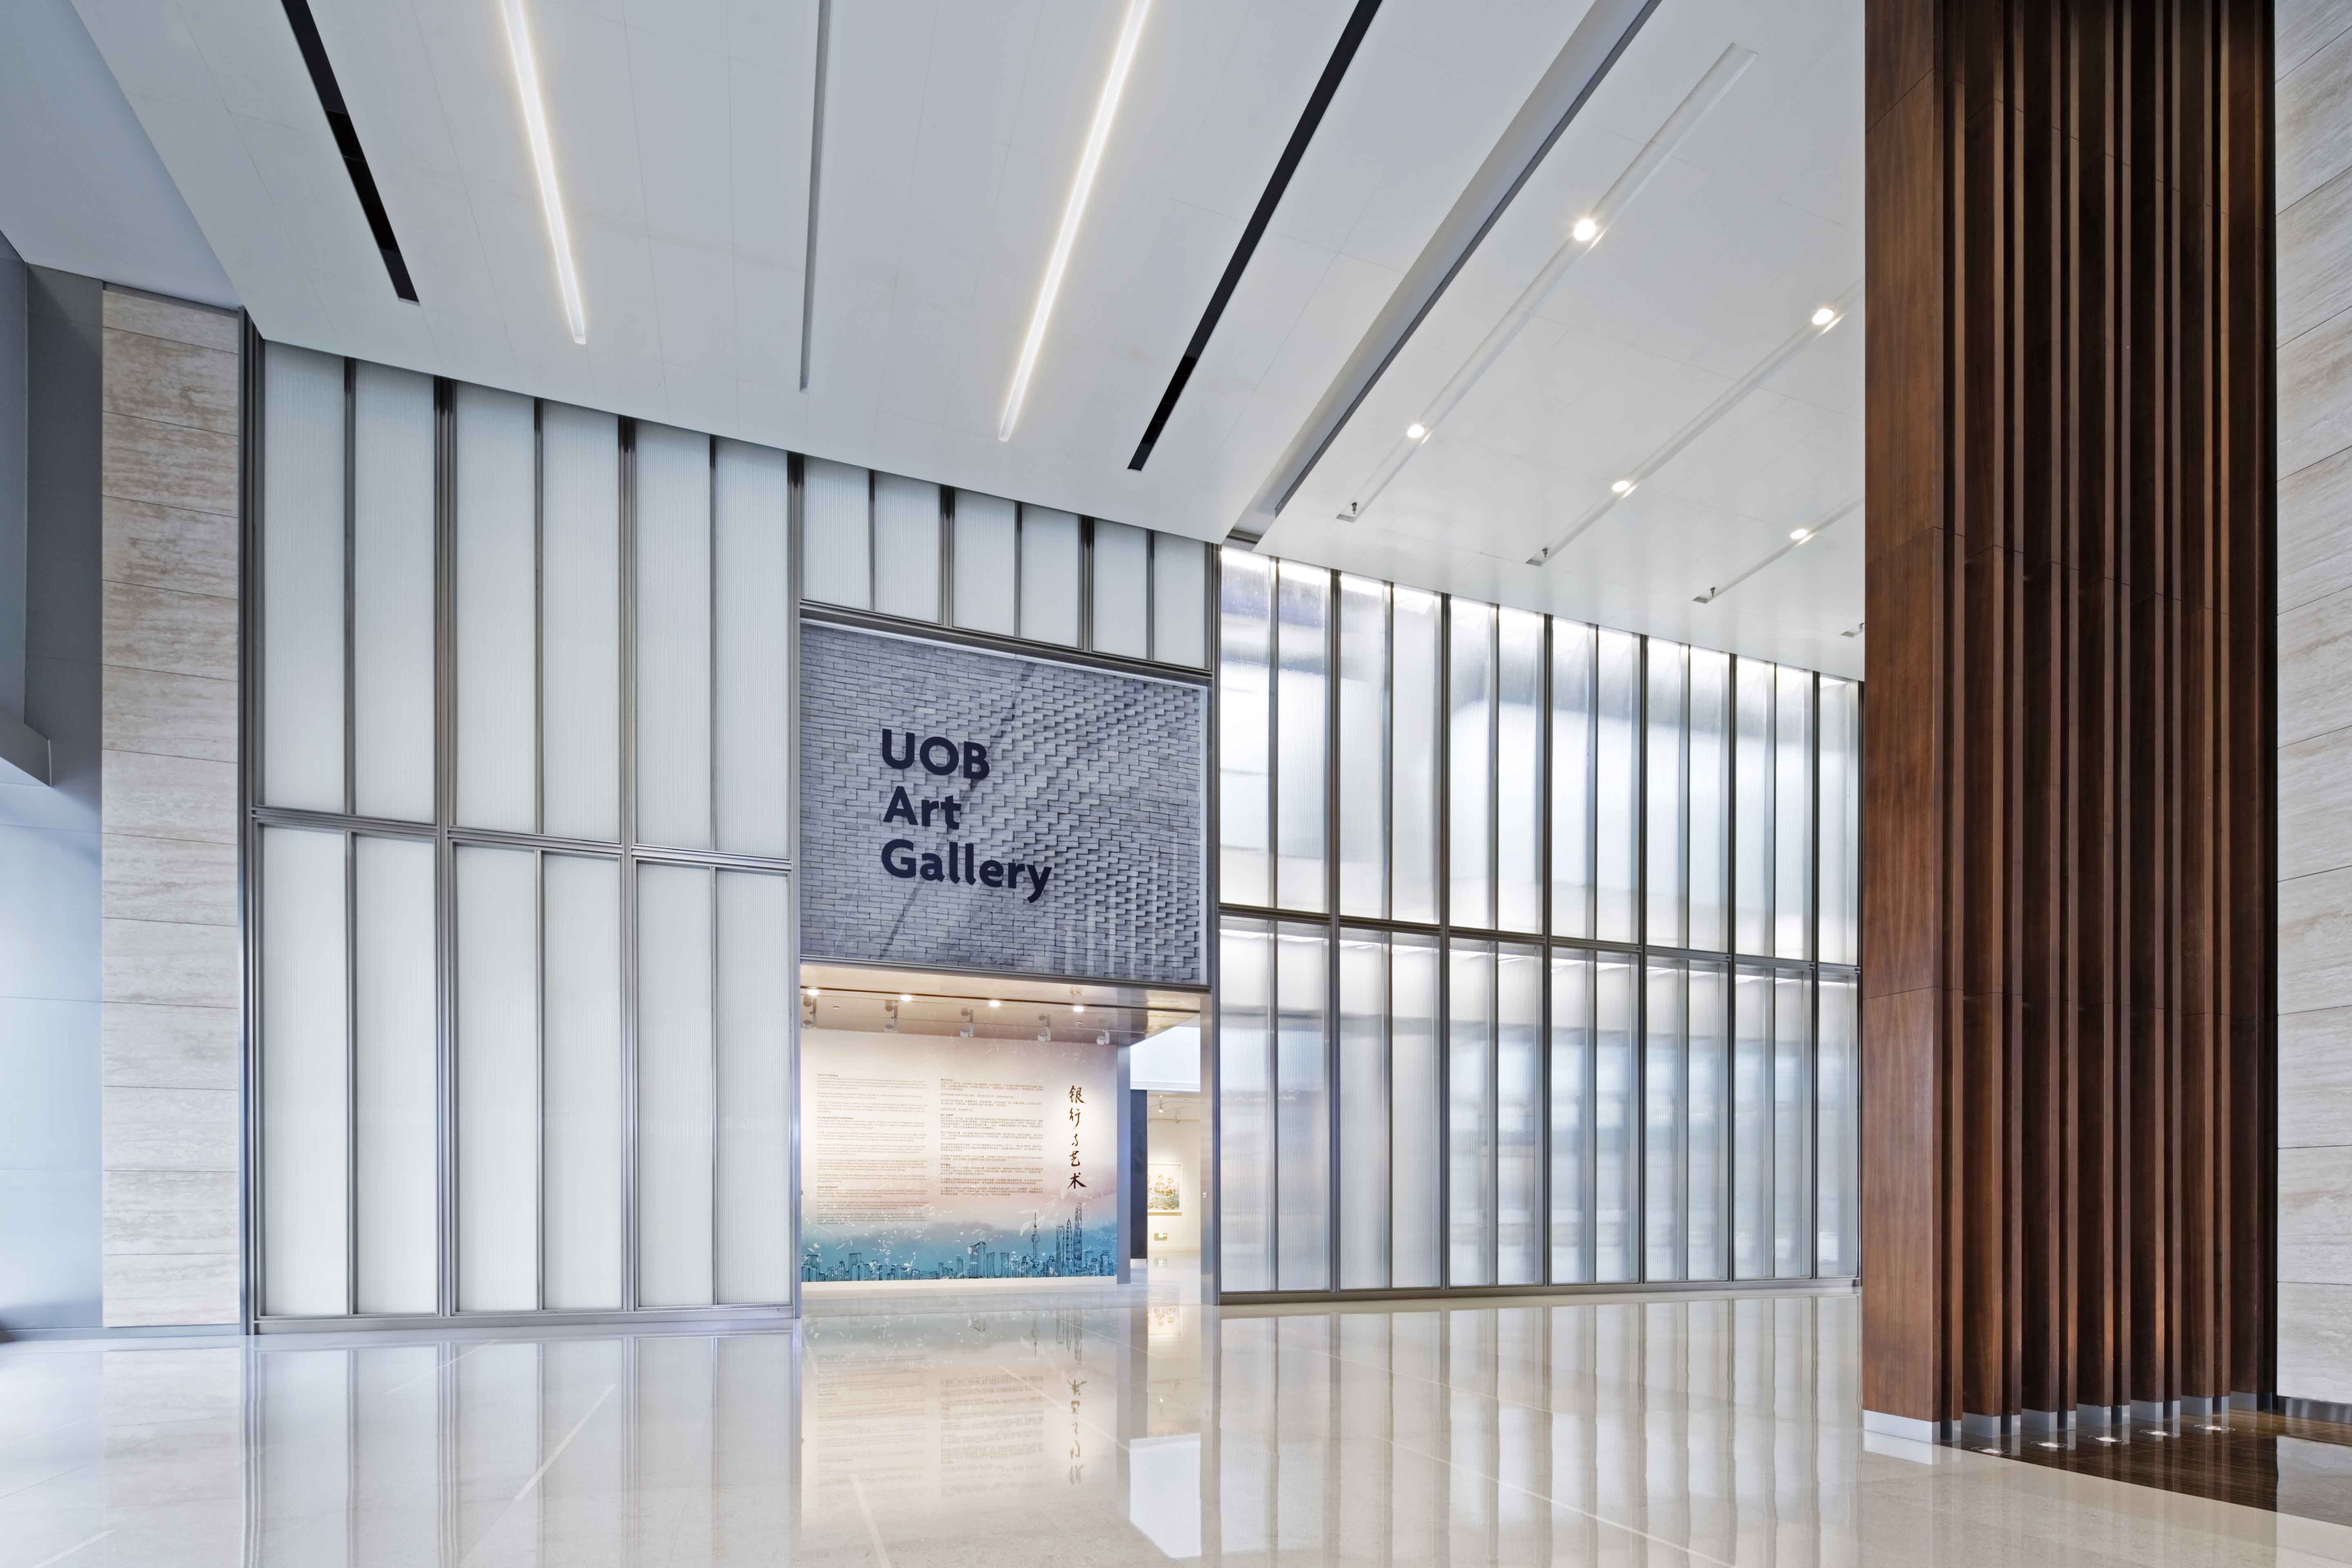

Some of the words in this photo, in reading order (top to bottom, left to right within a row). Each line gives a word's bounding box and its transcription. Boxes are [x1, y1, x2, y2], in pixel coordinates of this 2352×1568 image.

[882, 728, 990, 780] UOB
[883, 786, 961, 830] Art
[881, 839, 1052, 903] Gallery
